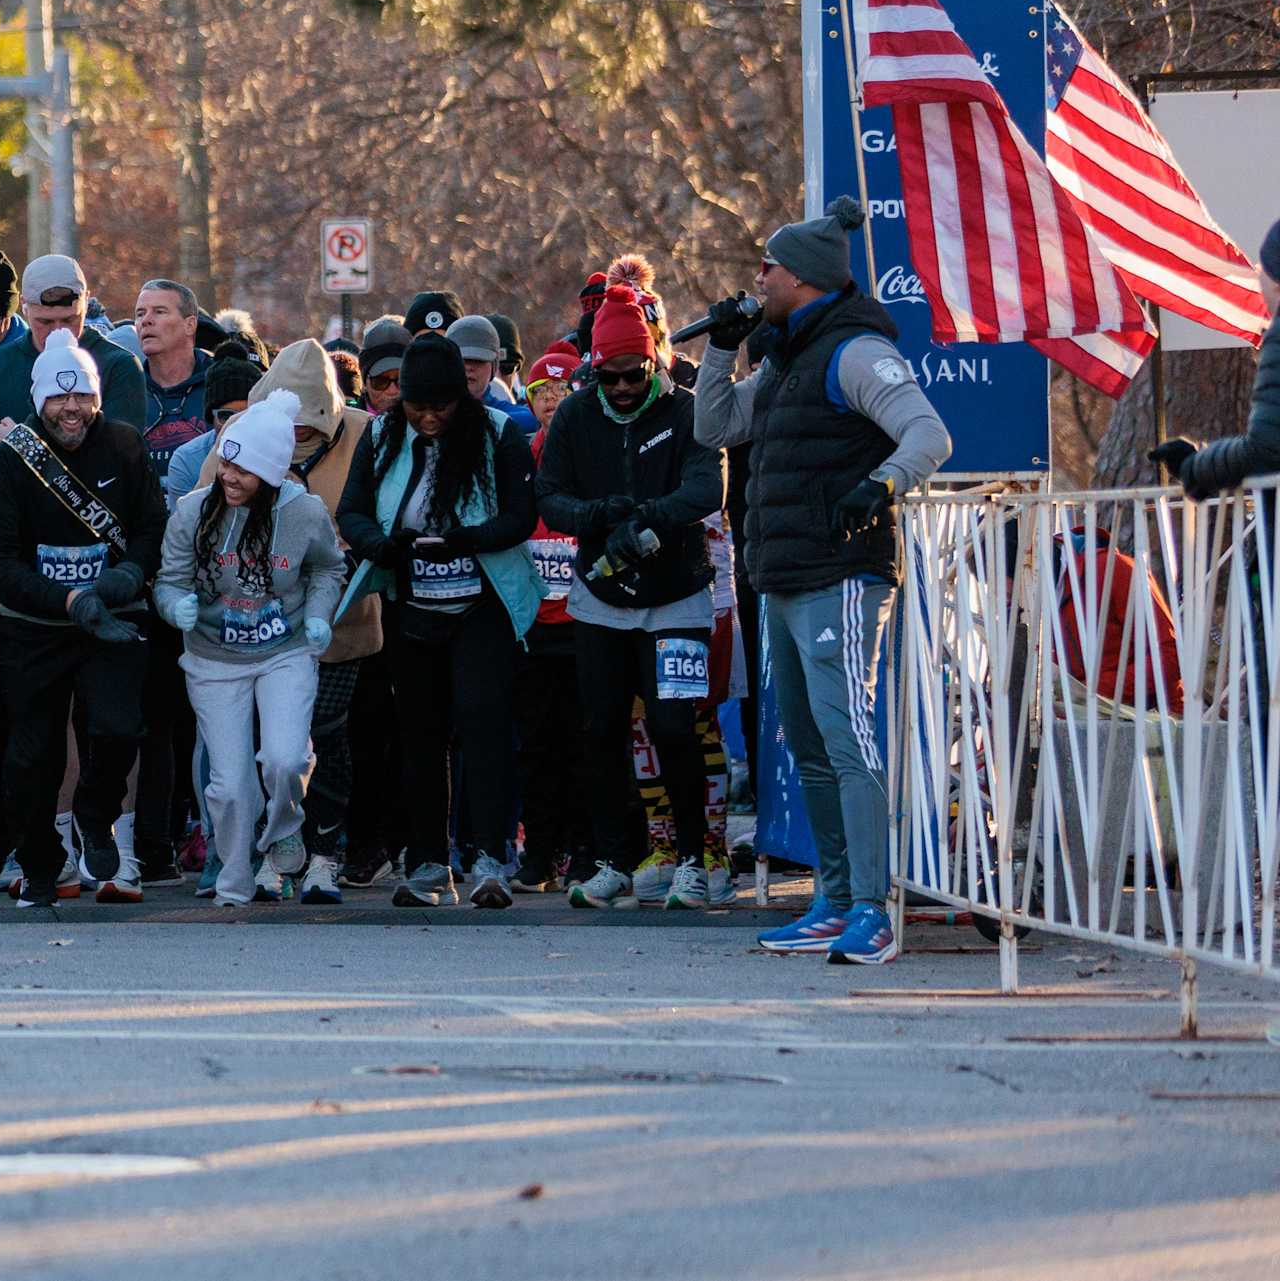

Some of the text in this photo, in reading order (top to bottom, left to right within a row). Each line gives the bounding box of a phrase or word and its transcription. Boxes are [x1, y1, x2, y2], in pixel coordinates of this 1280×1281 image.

[646, 428, 673, 449] TERREX
[42, 561, 103, 581] D2307
[224, 617, 288, 645] D2308
[664, 657, 707, 678] E166
